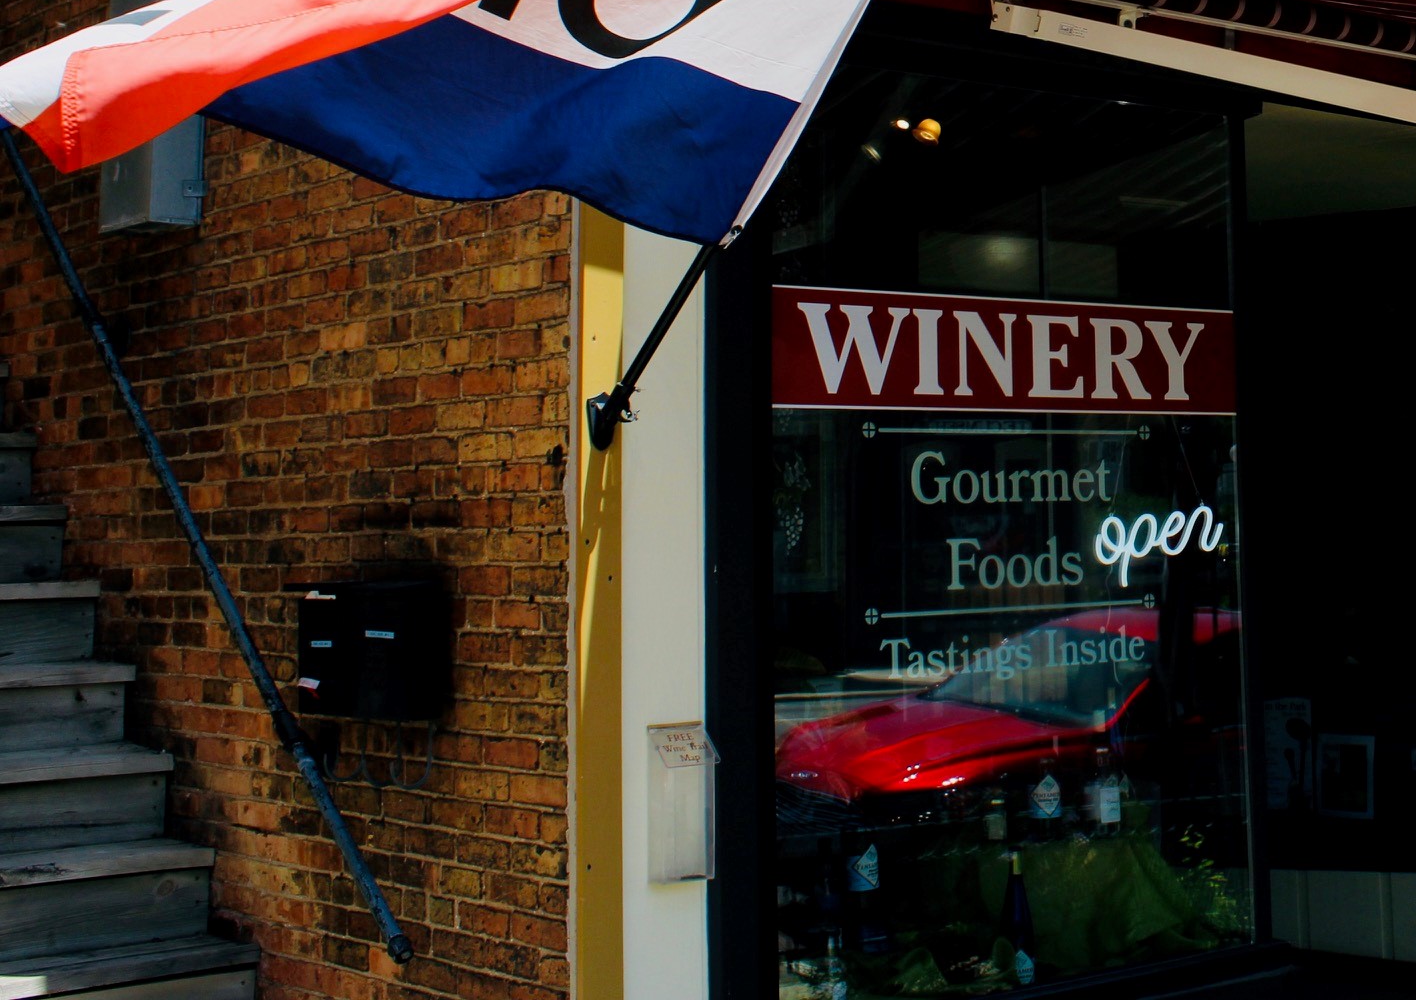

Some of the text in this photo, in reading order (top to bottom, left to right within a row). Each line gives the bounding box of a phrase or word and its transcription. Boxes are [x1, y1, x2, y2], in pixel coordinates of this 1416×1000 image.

[797, 301, 1205, 401] WINERY
[910, 450, 1112, 505] Gourmet
[946, 535, 1085, 591] Foods
[1094, 504, 1224, 588] open
[879, 625, 1146, 681] Tastings Inside
[666, 732, 695, 742] FREE
